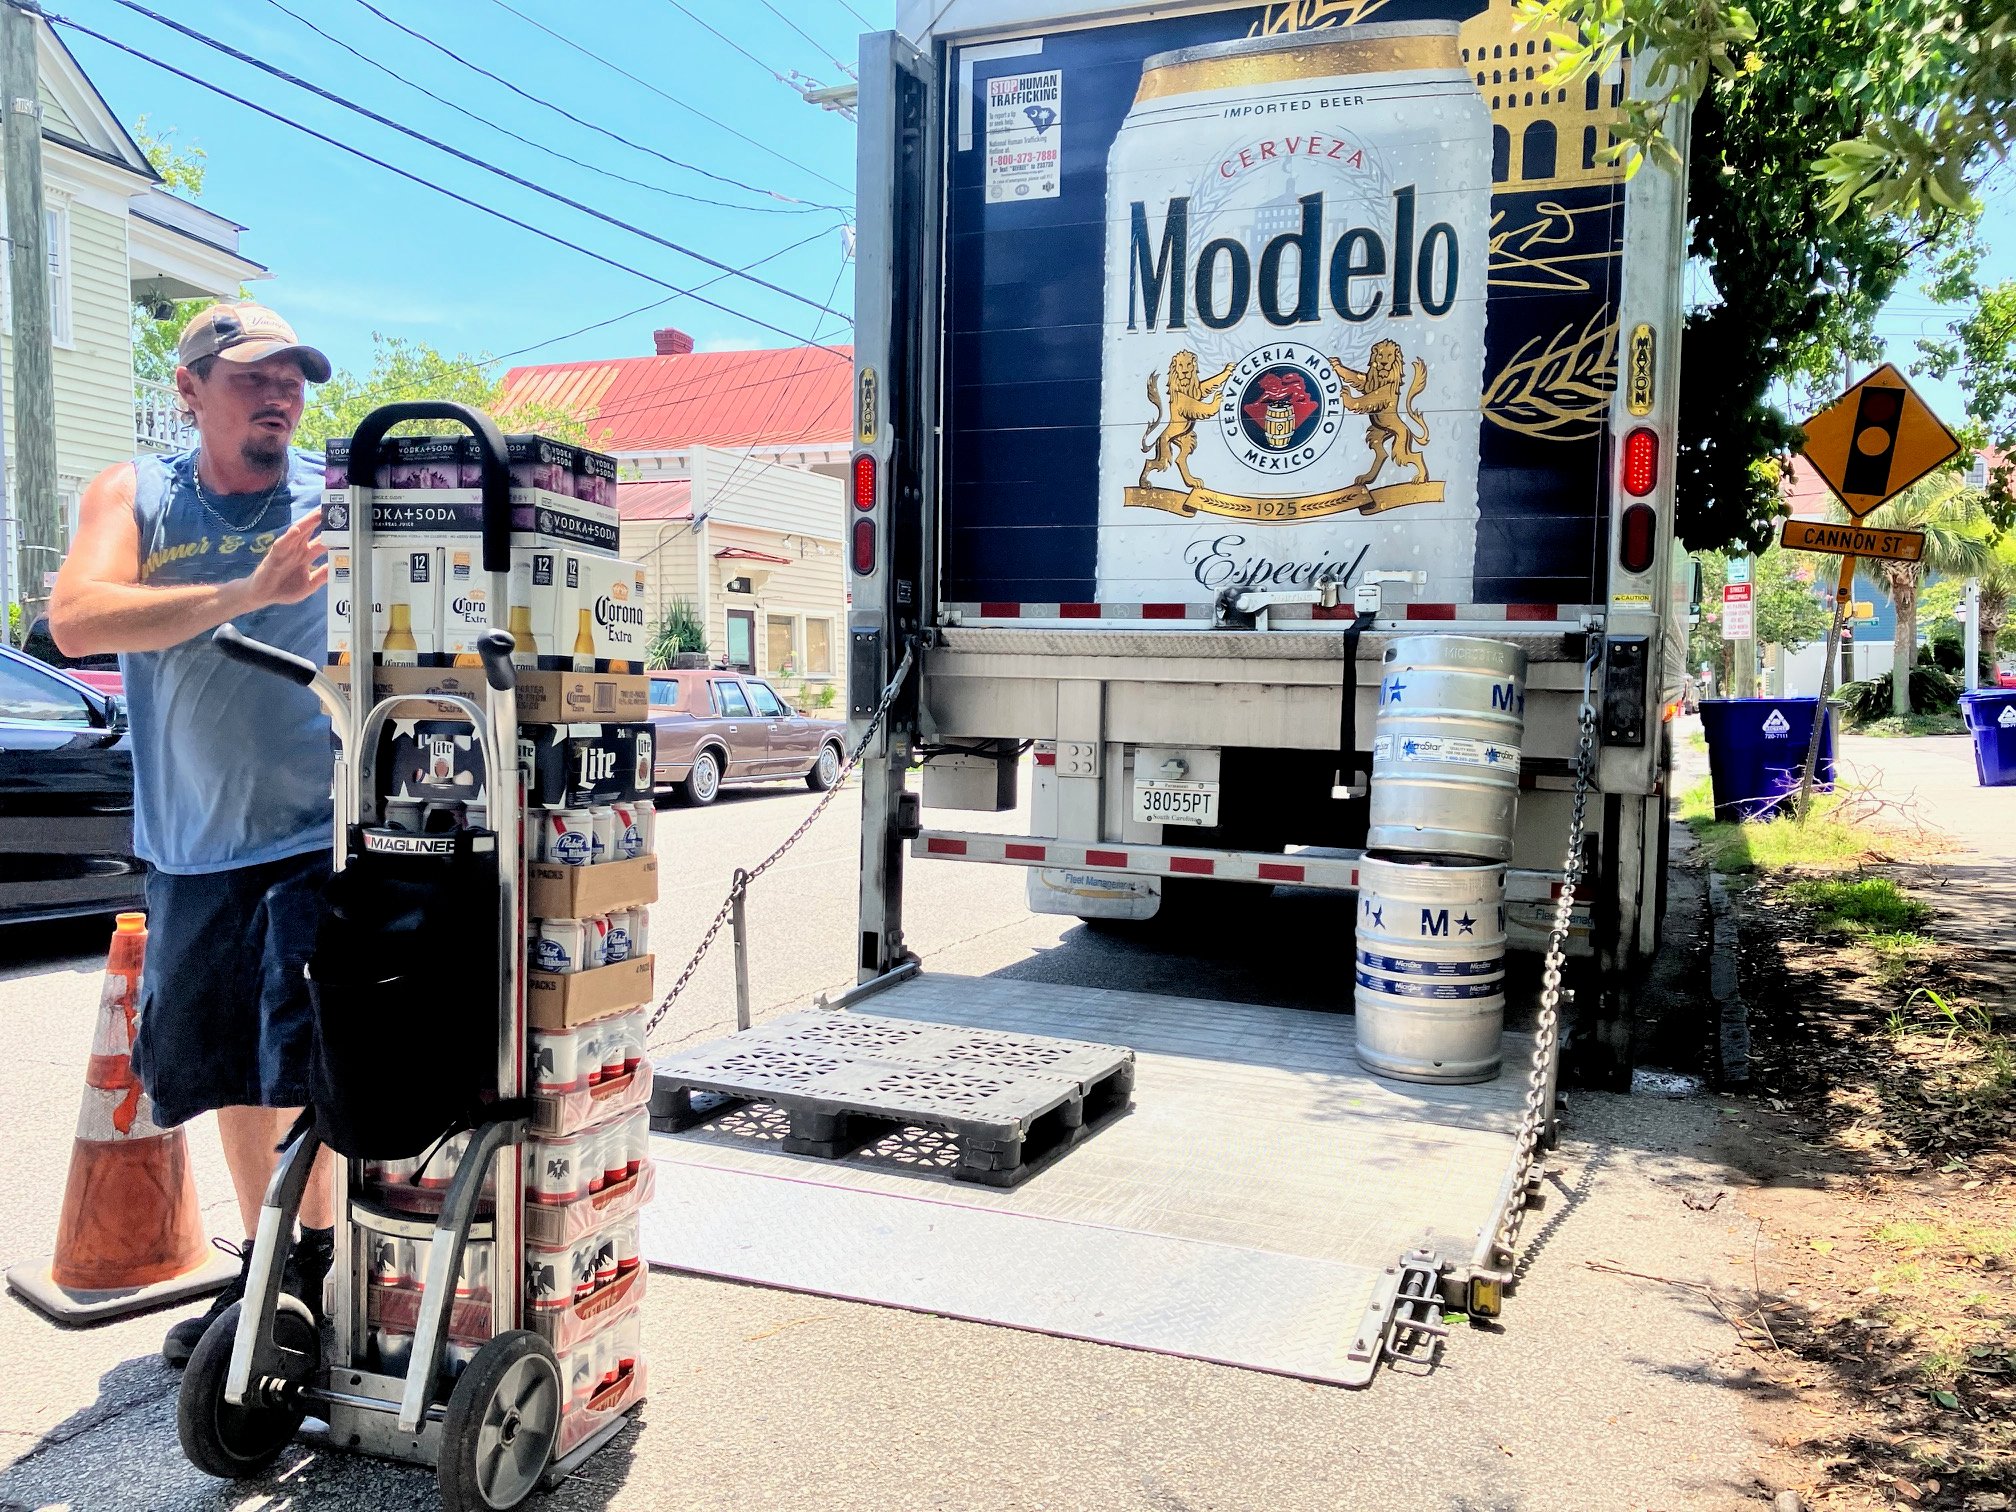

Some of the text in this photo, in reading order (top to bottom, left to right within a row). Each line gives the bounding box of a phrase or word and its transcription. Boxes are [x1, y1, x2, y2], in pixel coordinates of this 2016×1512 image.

[991, 75, 1057, 95] STOP HUMAN
[991, 87, 1058, 107] TRAFFICKING
[1223, 95, 1364, 119] IMPORTED BEER
[1219, 135, 1365, 179] CERVEZA
[1126, 183, 1461, 334] Modelo
[1634, 336, 1650, 405] MAXON
[1223, 347, 1340, 438] CERVECERIA MODELO
[863, 376, 872, 436] MAXON
[551, 446, 572, 460] VODKA
[1243, 446, 1316, 470] MEXICO
[595, 459, 615, 471] VODKA
[373, 507, 457, 521] DKA+SODA
[1256, 501, 1297, 517] 1925
[553, 514, 617, 543] VODKA+SODA
[218, 534, 246, 554] &
[1804, 527, 1903, 554] CANNON ST
[414, 555, 426, 570] 12
[537, 557, 549, 572] 12
[568, 560, 577, 575] 12
[1183, 534, 1371, 592] Especial
[452, 597, 486, 615] Coro
[594, 594, 644, 627] Corona
[605, 623, 633, 644] Extra
[1492, 683, 1514, 712] M
[616, 728, 626, 739] 24
[432, 740, 452, 757] Lite
[517, 744, 534, 757] ite
[637, 739, 651, 757] Lite
[1402, 739, 1442, 751] MicroStar
[577, 745, 617, 790] Lite
[1143, 790, 1212, 814] 38055PT
[1064, 873, 1085, 884] Fleet
[1421, 908, 1449, 937] M
[1535, 908, 1557, 921] Flee
[1394, 959, 1423, 969] MicroStar
[1394, 982, 1423, 993] MicroStar
